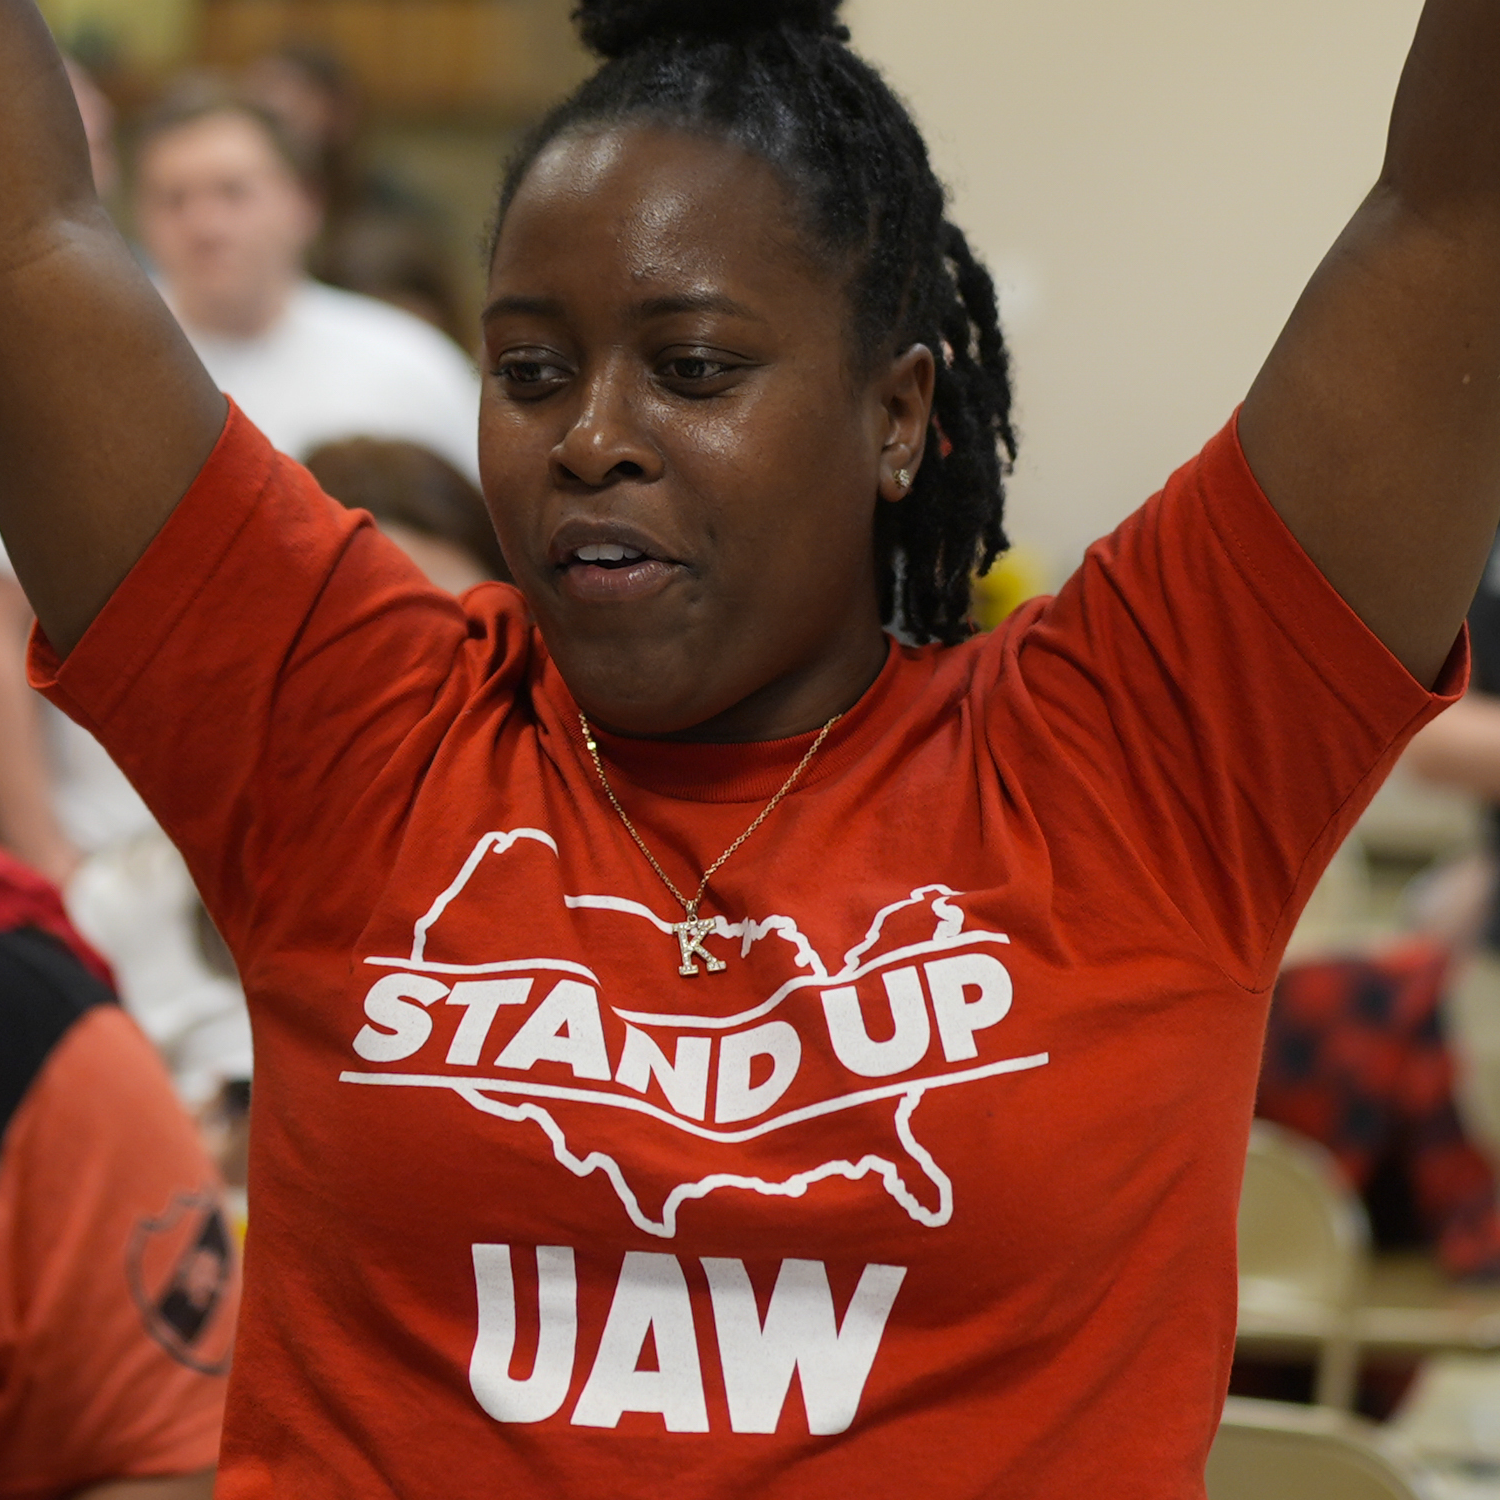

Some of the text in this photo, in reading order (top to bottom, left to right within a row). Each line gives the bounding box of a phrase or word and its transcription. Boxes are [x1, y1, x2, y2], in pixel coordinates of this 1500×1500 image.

[672, 919, 728, 977] K
[351, 953, 1014, 1125] STAND UP
[467, 1242, 908, 1437] UAW
